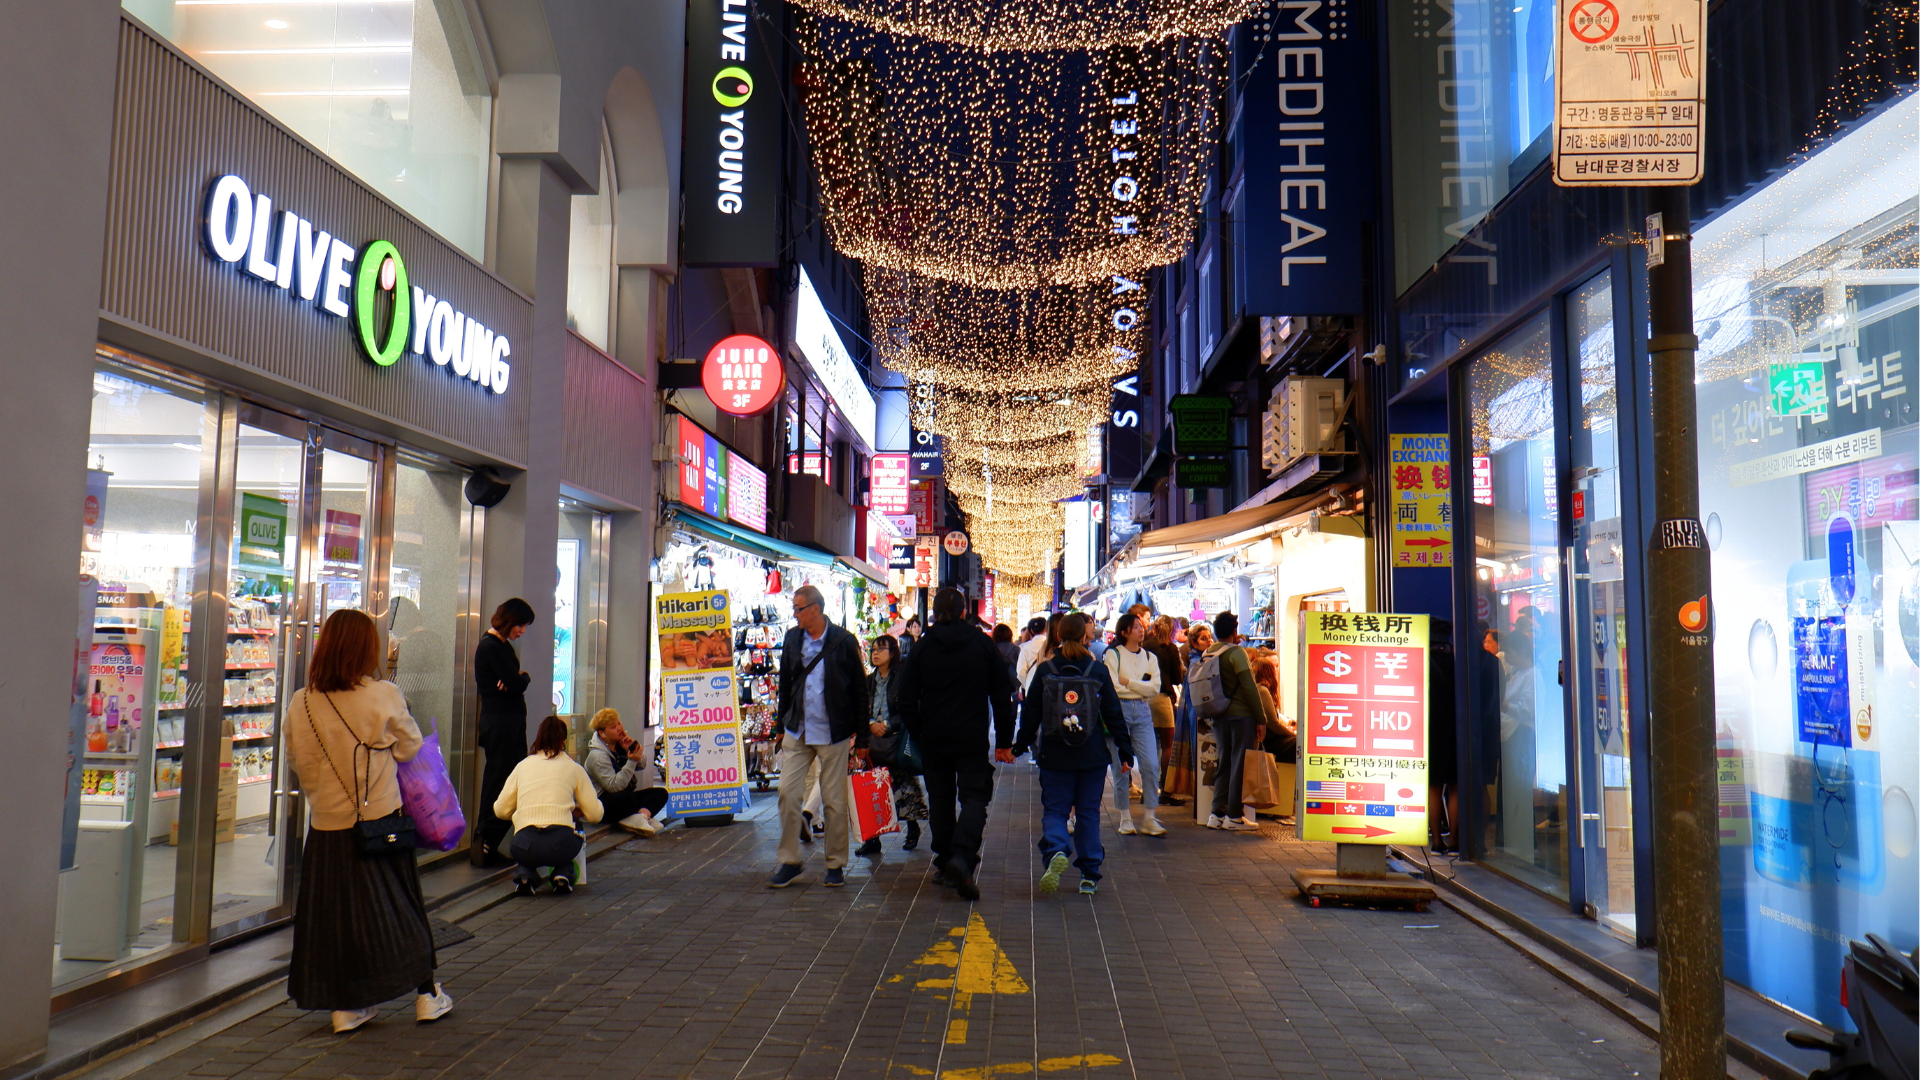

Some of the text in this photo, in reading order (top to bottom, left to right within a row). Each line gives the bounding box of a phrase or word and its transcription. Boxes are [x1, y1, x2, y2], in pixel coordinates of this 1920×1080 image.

[1578, 16, 1610, 25] 통행금지
[1598, 107, 1668, 121] 명동관광특구
[1671, 106, 1693, 121] 일대
[1277, 0, 1327, 286] MEDIHEAL
[1590, 133, 1631, 149] 연중(매일)
[1633, 132, 1693, 148] 10:00~23:00
[718, 110, 744, 214] YOUNG
[1575, 159, 1680, 174] 남대문경찰서장
[1112, 90, 1141, 428] SAVOY HOTEL
[205, 173, 511, 395] OLIVE YOUNG
[716, 347, 769, 364] JUNO
[721, 364, 763, 379] HAIR
[1836, 350, 1907, 413] 리부트
[732, 394, 751, 407] 3F
[1401, 437, 1450, 450] MONEY
[1781, 449, 1817, 471] 아미노산을
[1817, 444, 1833, 464] 더해
[1834, 441, 1851, 460] 수분
[1852, 434, 1878, 457] 리부트
[920, 462, 930, 471] 2F
[1189, 474, 1220, 483] COFFEE
[251, 521, 277, 539] OLIVE
[915, 547, 932, 587] 부동산
[97, 595, 126, 604] SNACK
[658, 596, 725, 615] Hikari 5F
[985, 597, 993, 617] HAIR
[660, 612, 726, 630] Massage
[1319, 613, 1413, 634] 换钱所
[1322, 632, 1409, 646] Money Exchange
[1681, 636, 1708, 646] 서울중구
[1857, 634, 1865, 702] moisturizing
[679, 675, 706, 683] massage
[711, 679, 730, 688] 40min
[673, 682, 699, 709] 足
[703, 690, 731, 698] マッサージ
[1321, 705, 1353, 732] 元
[1370, 710, 1412, 731] HKD
[668, 733, 702, 742] Whole body
[716, 735, 734, 744] 60min
[673, 740, 702, 757] 全身
[706, 747, 736, 755] マッサージ
[1308, 756, 1428, 770] 日本円特別優待
[1327, 768, 1398, 780] 高いレート
[671, 794, 691, 802] OPEN
